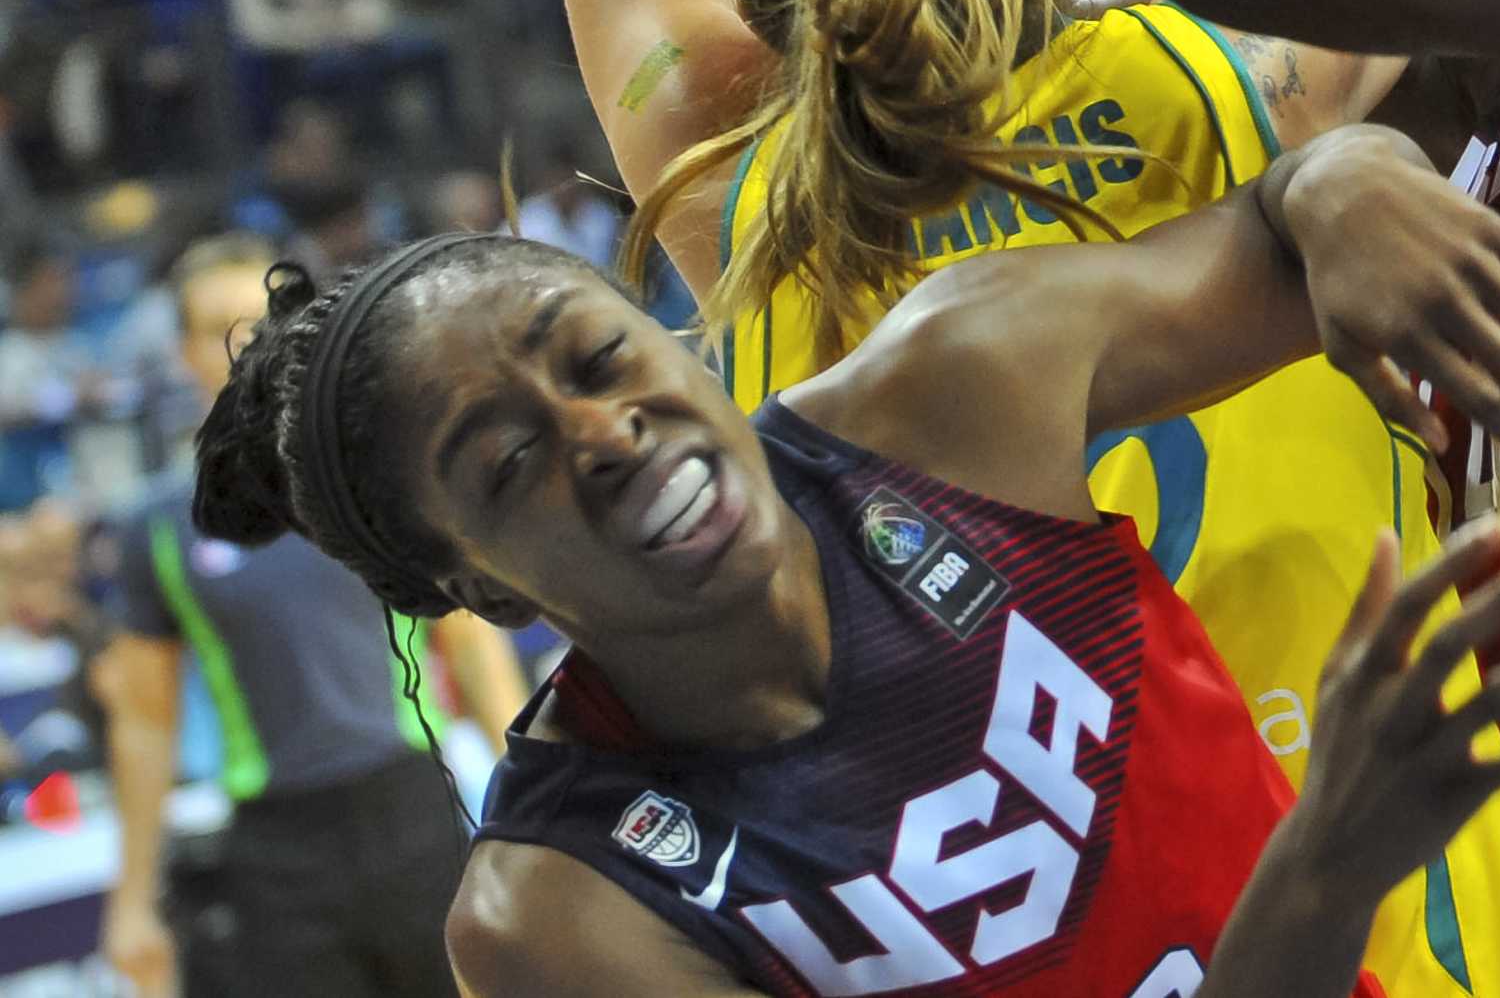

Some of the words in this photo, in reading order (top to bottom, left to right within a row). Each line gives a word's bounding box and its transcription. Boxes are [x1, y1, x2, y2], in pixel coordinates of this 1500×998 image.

[907, 99, 1145, 259] ANCIS
[919, 551, 970, 602] FIBA
[740, 609, 1113, 997] USA
